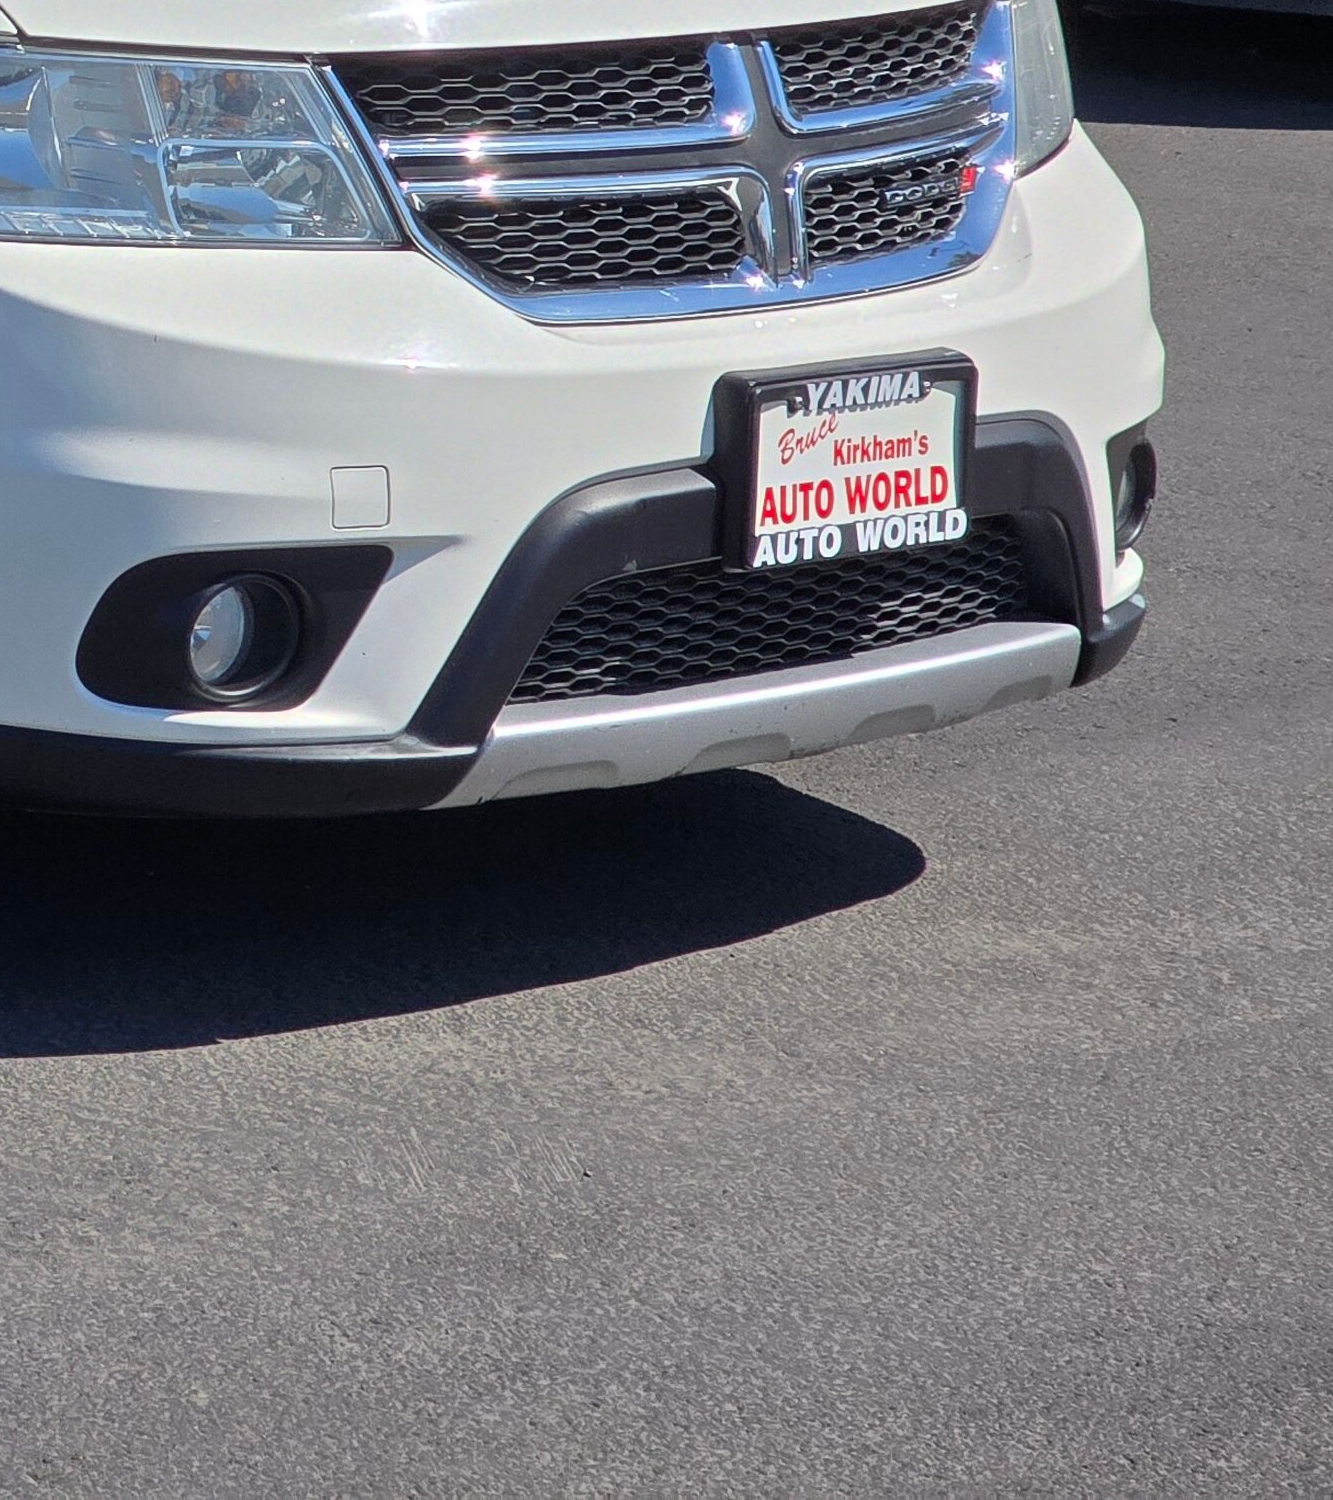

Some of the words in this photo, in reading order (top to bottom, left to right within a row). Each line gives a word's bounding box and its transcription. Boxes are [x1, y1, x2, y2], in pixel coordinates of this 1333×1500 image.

[806, 371, 921, 411] YAKIMA
[778, 414, 839, 465] Bruce
[833, 429, 929, 466] Kirkham's
[759, 479, 834, 527] AUTO
[844, 465, 949, 515] WORLD
[752, 525, 842, 568] AUTO
[855, 508, 968, 553] WORLD
